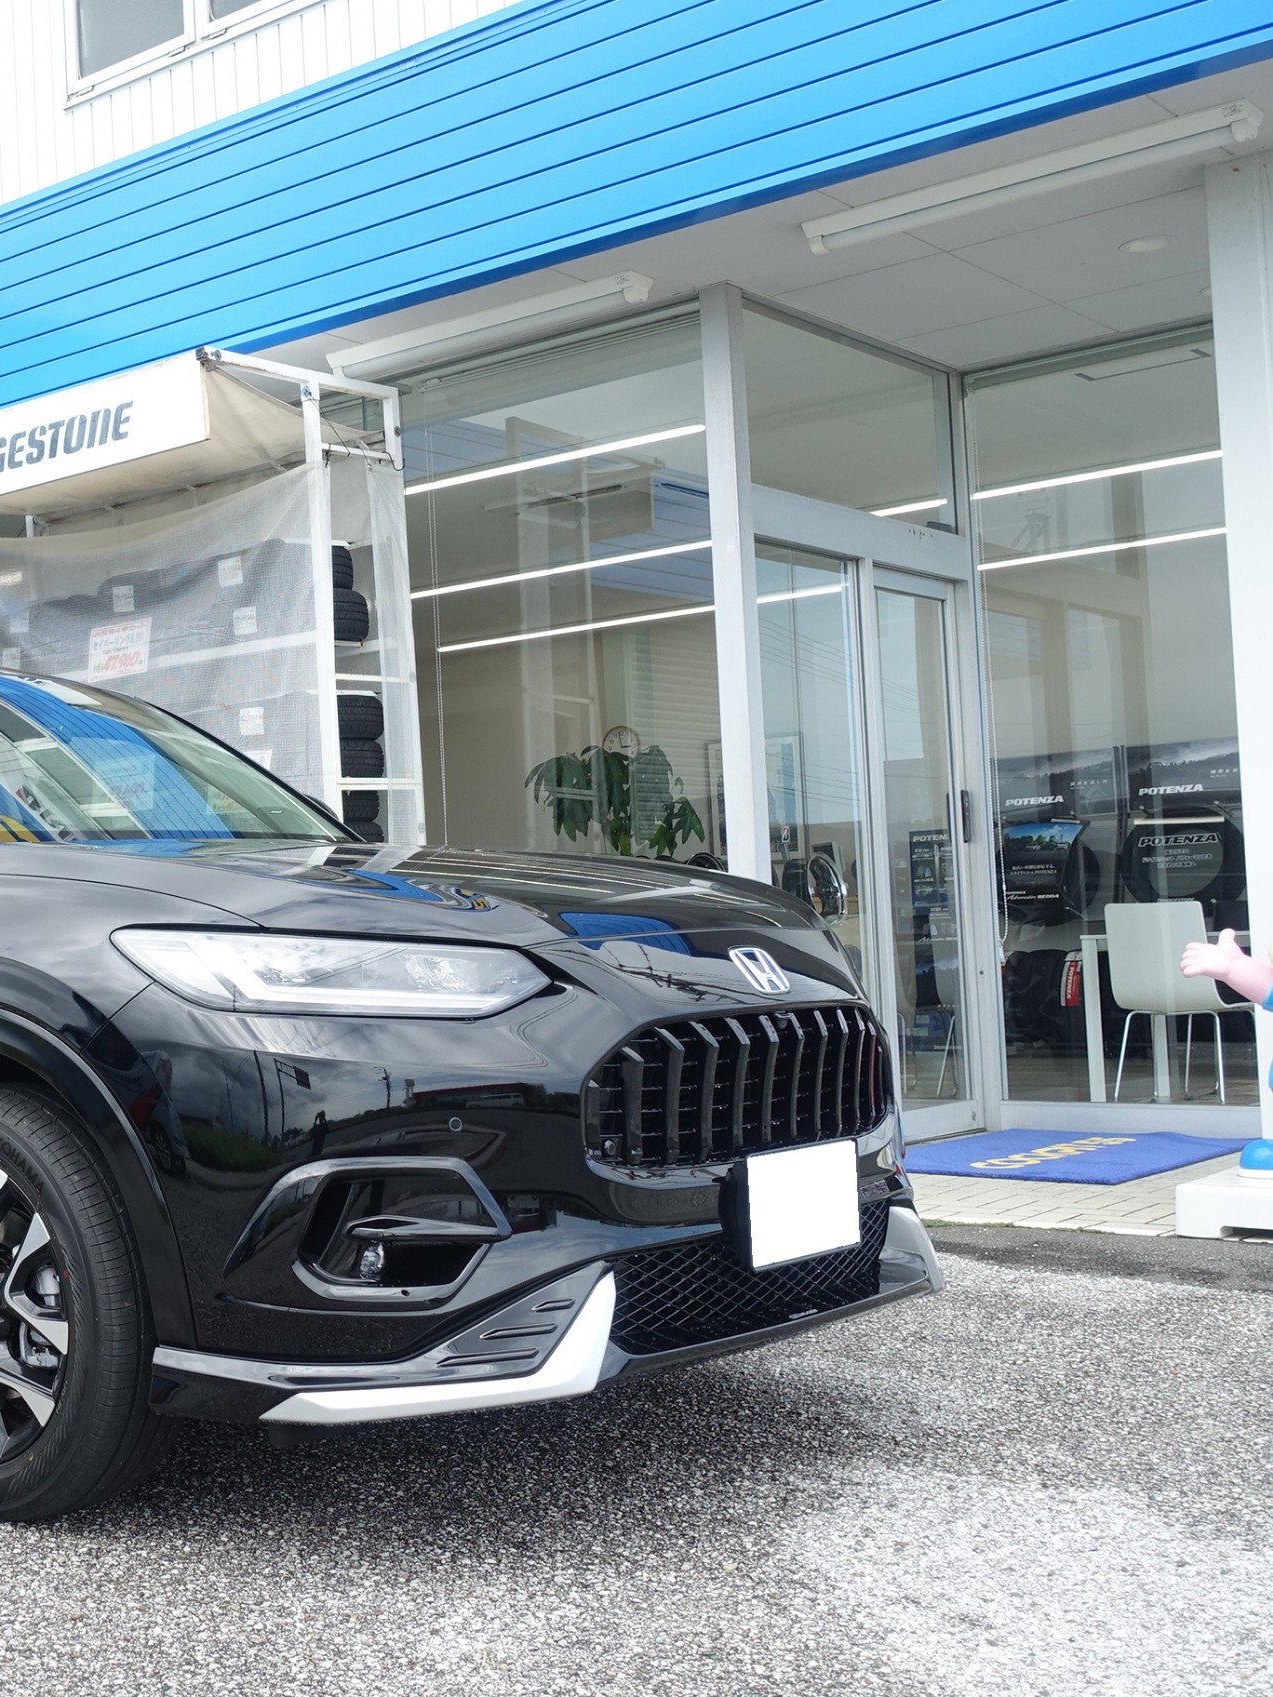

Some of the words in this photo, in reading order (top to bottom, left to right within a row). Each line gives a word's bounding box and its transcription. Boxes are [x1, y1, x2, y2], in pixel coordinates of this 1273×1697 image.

[1138, 784, 1204, 796] POTENZA
[1005, 795, 1064, 806] POTENZA
[1138, 832, 1219, 847] POTENZA
